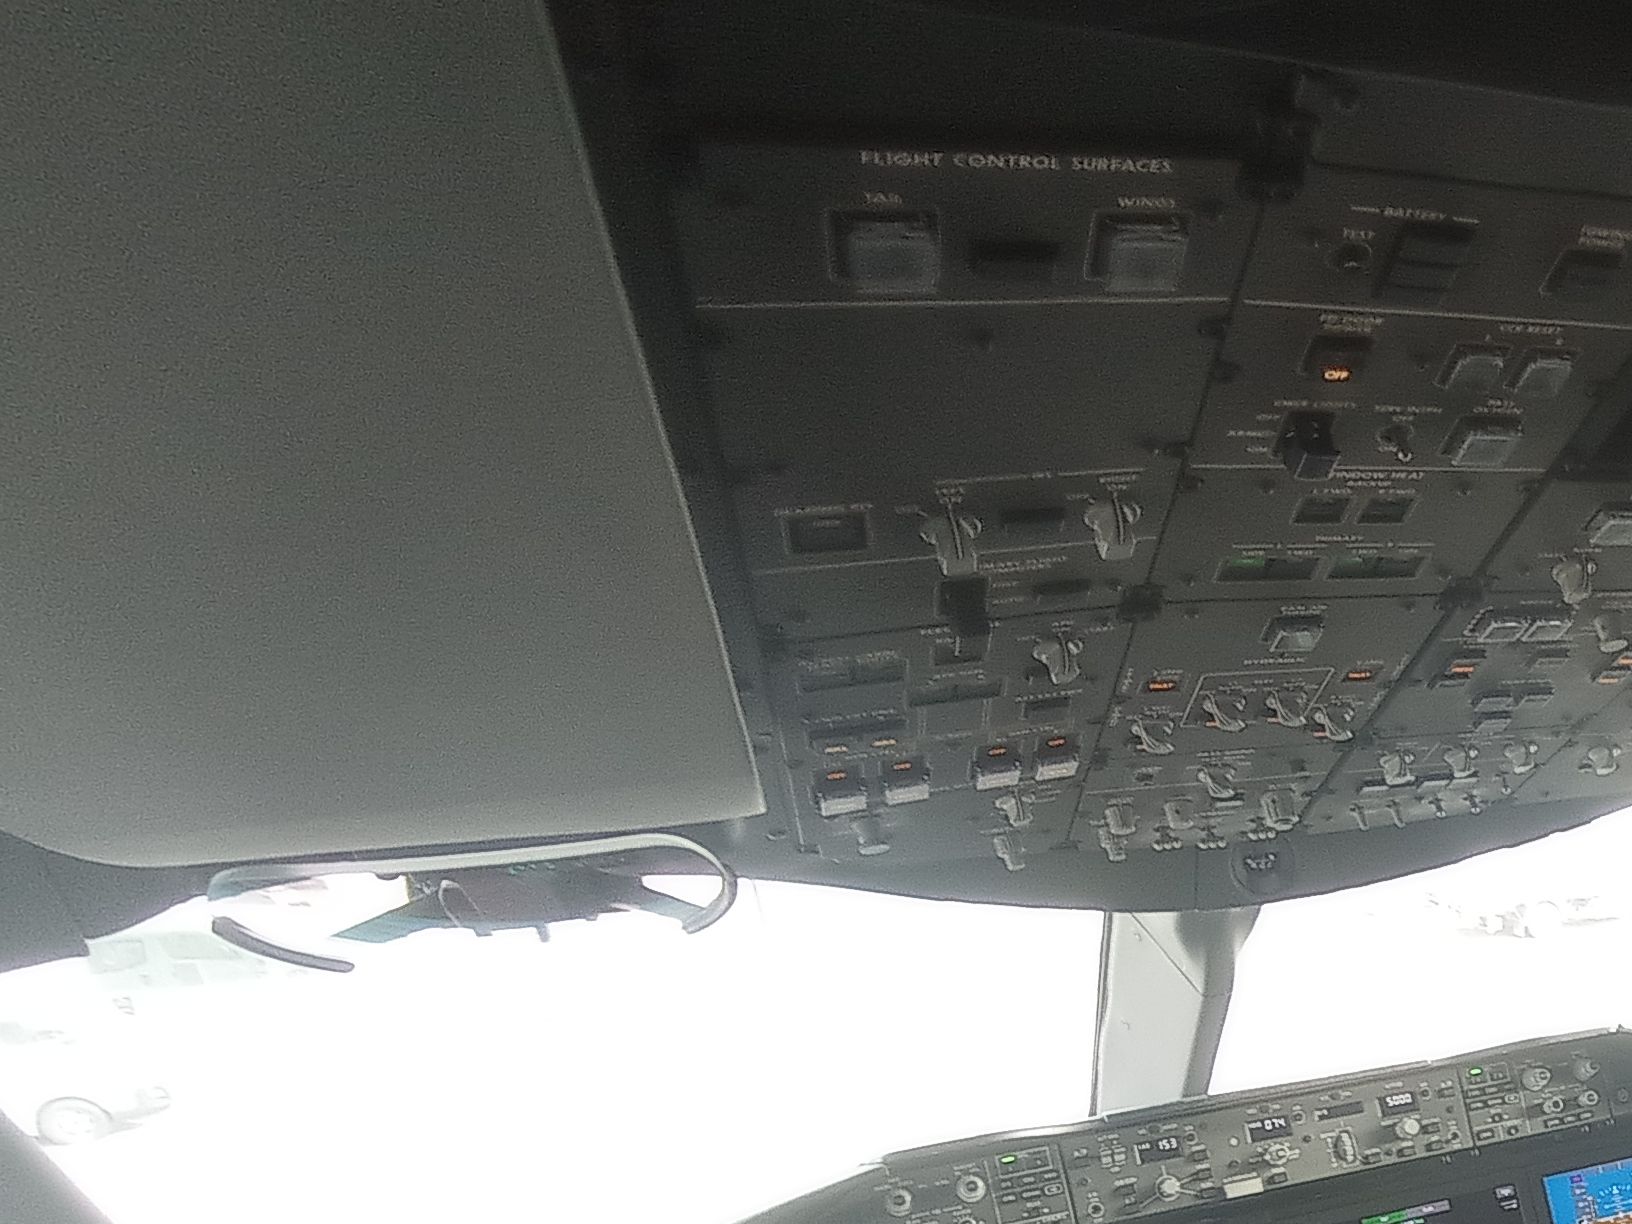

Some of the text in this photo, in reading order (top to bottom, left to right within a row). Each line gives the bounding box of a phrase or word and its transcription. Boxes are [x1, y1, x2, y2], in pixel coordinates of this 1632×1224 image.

[860, 151, 1174, 173] FLIGHT CONTROL SURFACES
[1382, 206, 1448, 221] BATTERY
[1323, 369, 1350, 381] OFF
[1384, 1092, 1413, 1107] 5000
[1157, 1137, 1178, 1150] 153
